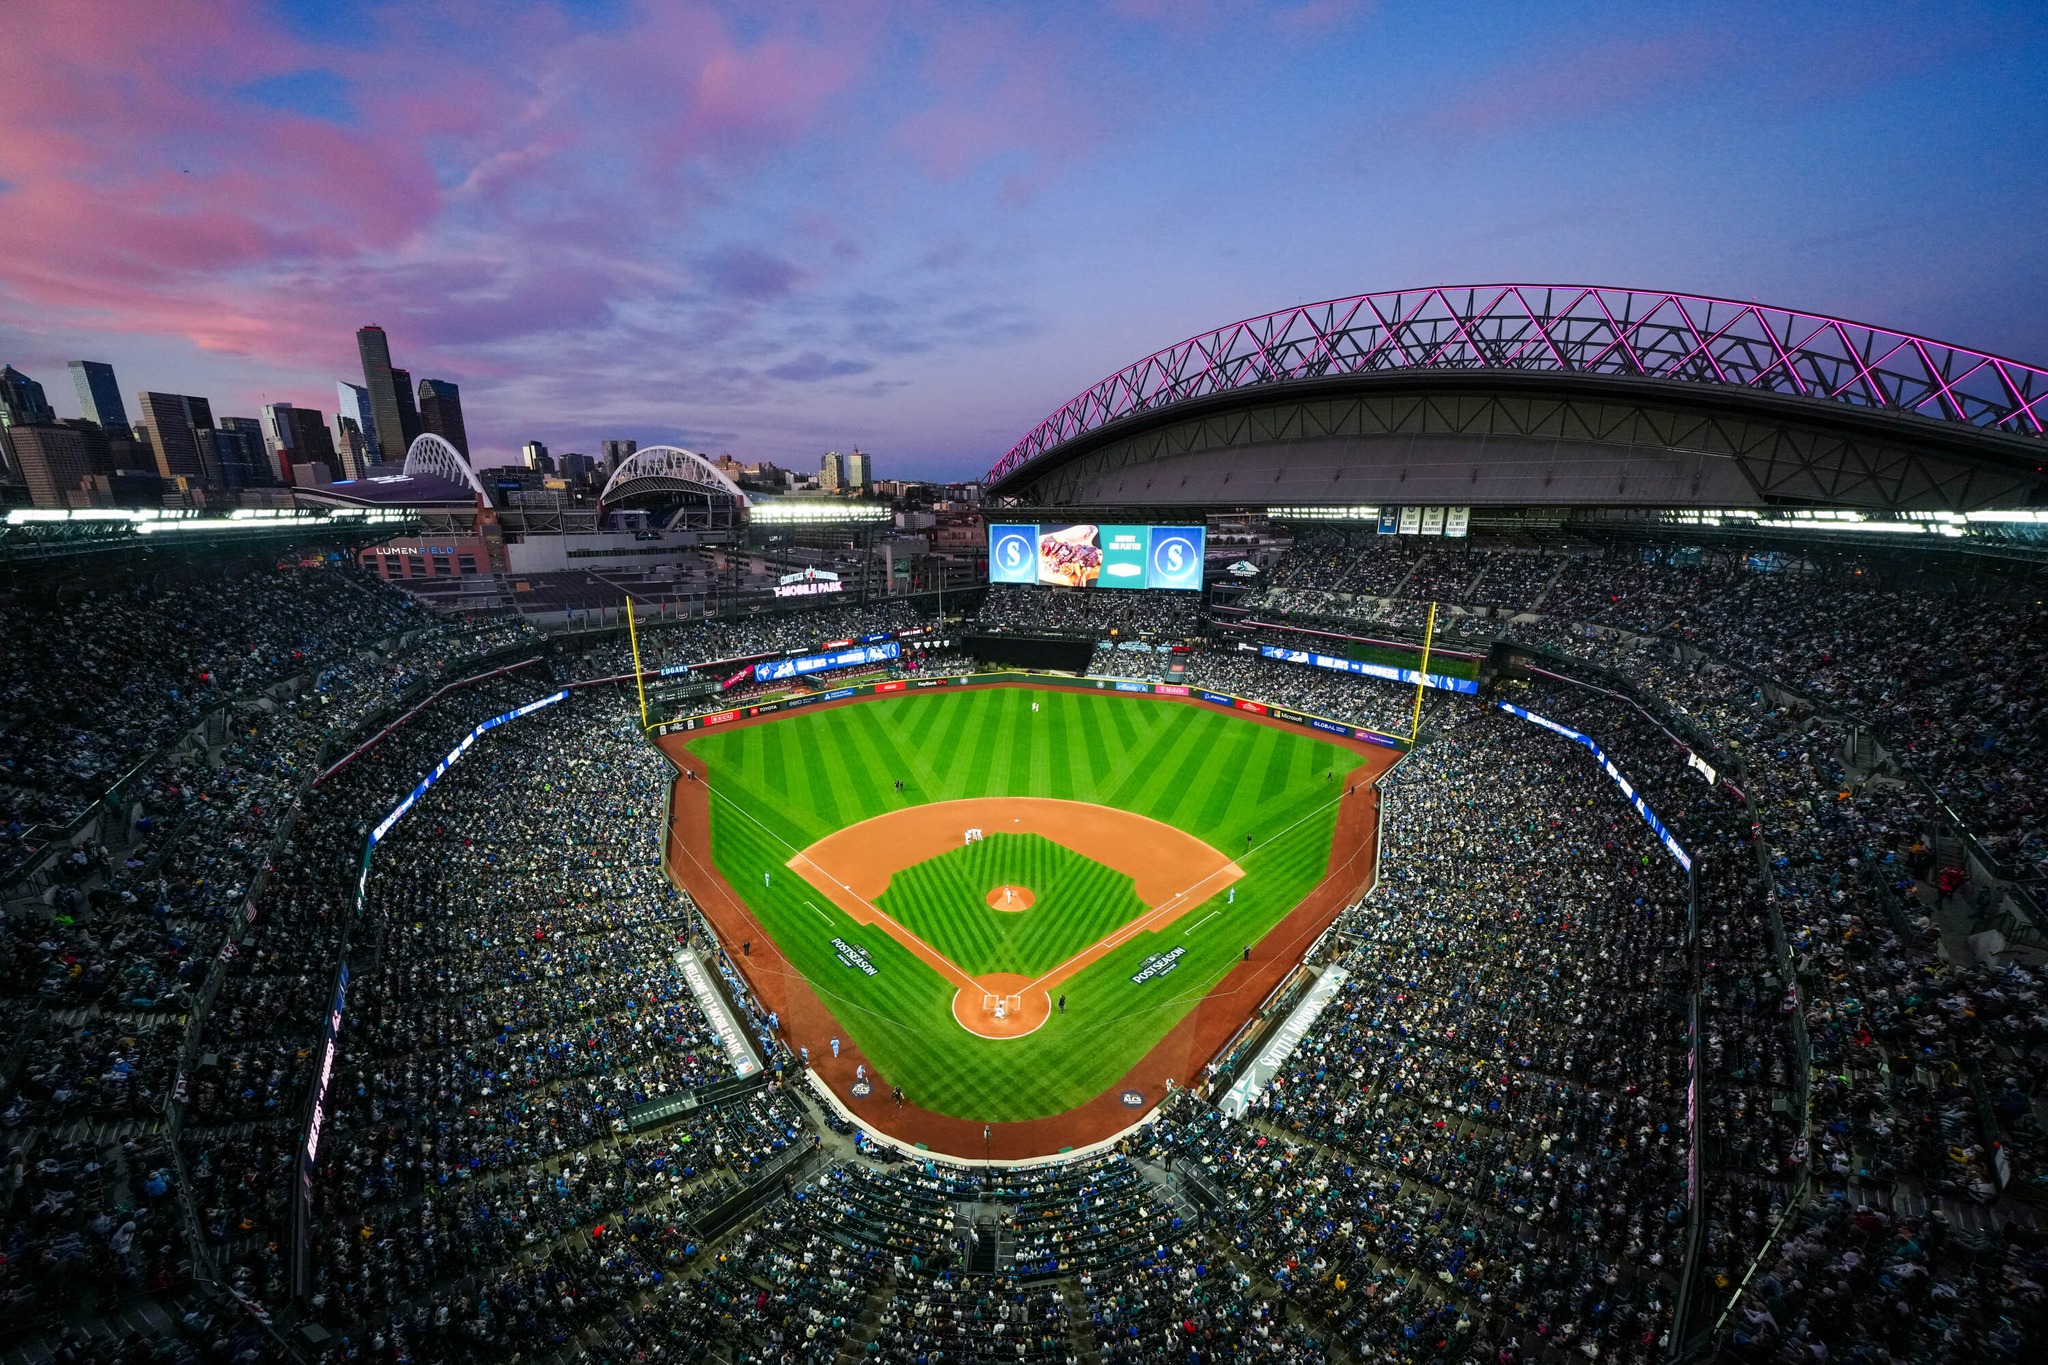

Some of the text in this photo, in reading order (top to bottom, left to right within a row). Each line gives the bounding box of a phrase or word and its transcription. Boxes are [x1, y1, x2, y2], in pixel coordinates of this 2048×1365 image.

[376, 546, 454, 555] LUMEN FIELD
[773, 581, 843, 597] T-MOBILE PARK
[1334, 658, 1349, 670] JAYS
[1361, 664, 1399, 680] MARINERS
[767, 686, 792, 694] NORTHWEST
[1281, 713, 1303, 723] Microsoft
[1314, 721, 1335, 731] GLOBAL
[831, 937, 878, 976] POSTSEASON
[1132, 947, 1186, 984] POSTSEASON
[684, 962, 745, 1058] WELCOME TO T-MOBILE PARK
[1260, 1033, 1298, 1072] SEATTLE
[1124, 1093, 1142, 1102] ALCS
